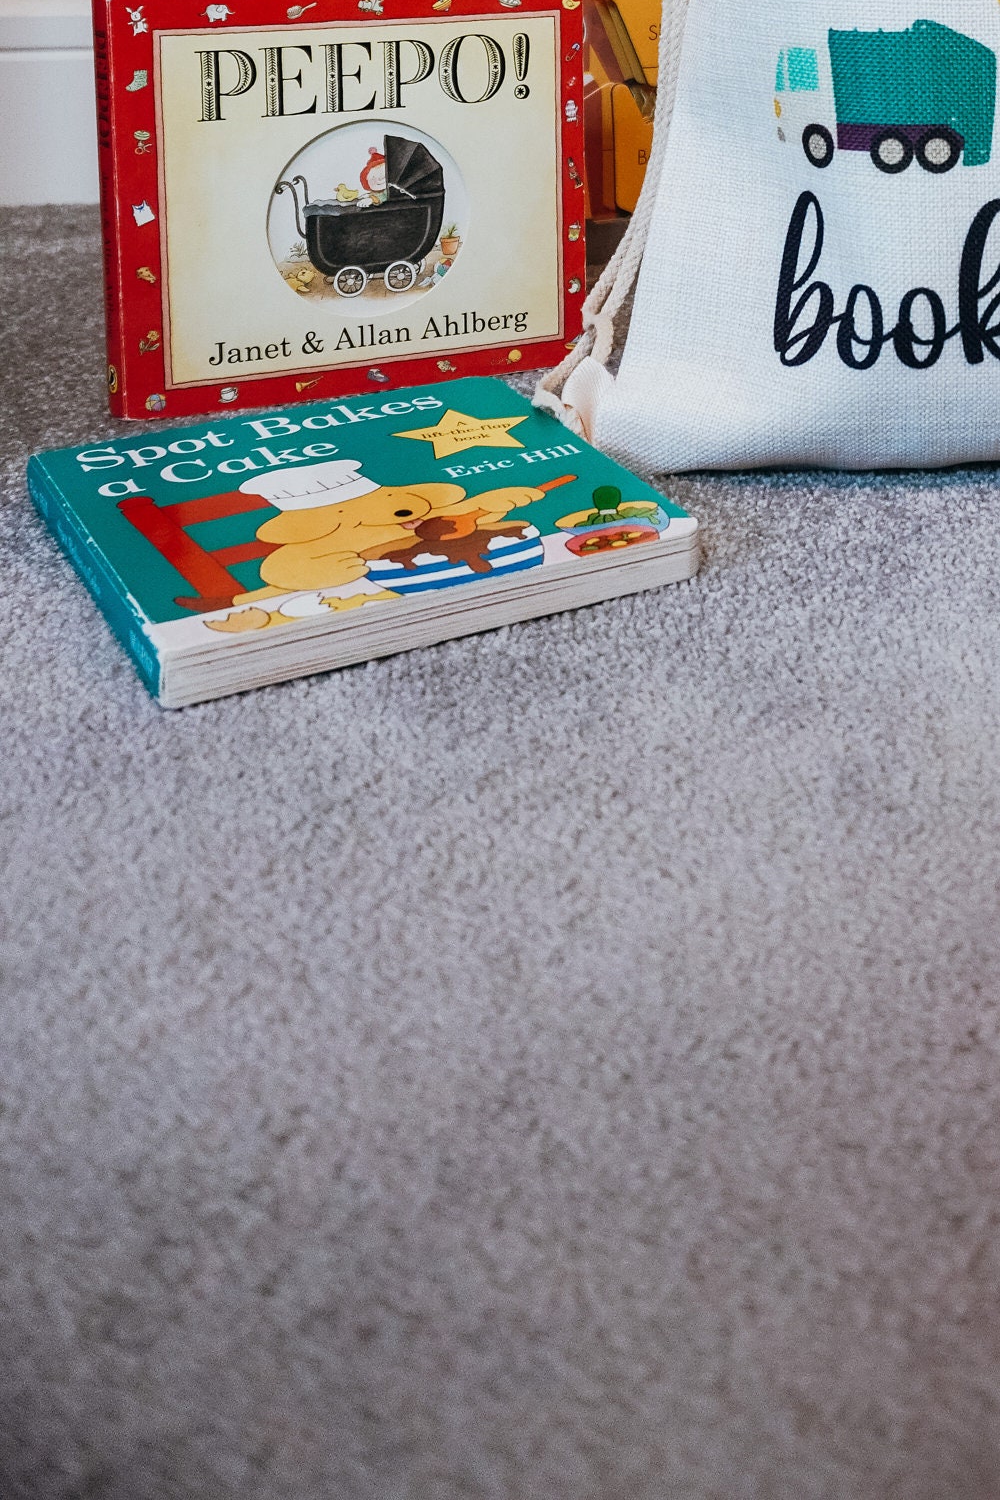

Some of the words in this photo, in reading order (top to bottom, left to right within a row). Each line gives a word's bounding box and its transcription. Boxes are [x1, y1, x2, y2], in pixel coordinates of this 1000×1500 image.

[194, 32, 530, 122] PEEPO!
[208, 337, 292, 366] Janet
[301, 331, 324, 354] &
[334, 324, 412, 351] Allan
[420, 311, 529, 340] Ahlberg
[76, 431, 234, 472] Spot
[241, 396, 443, 441] Bakes
[421, 422, 511, 439] lift-the-flap
[453, 433, 492, 442] book
[98, 478, 146, 497] a
[160, 442, 339, 483] Cake
[441, 457, 515, 479] Eric
[517, 443, 583, 464] Hill
